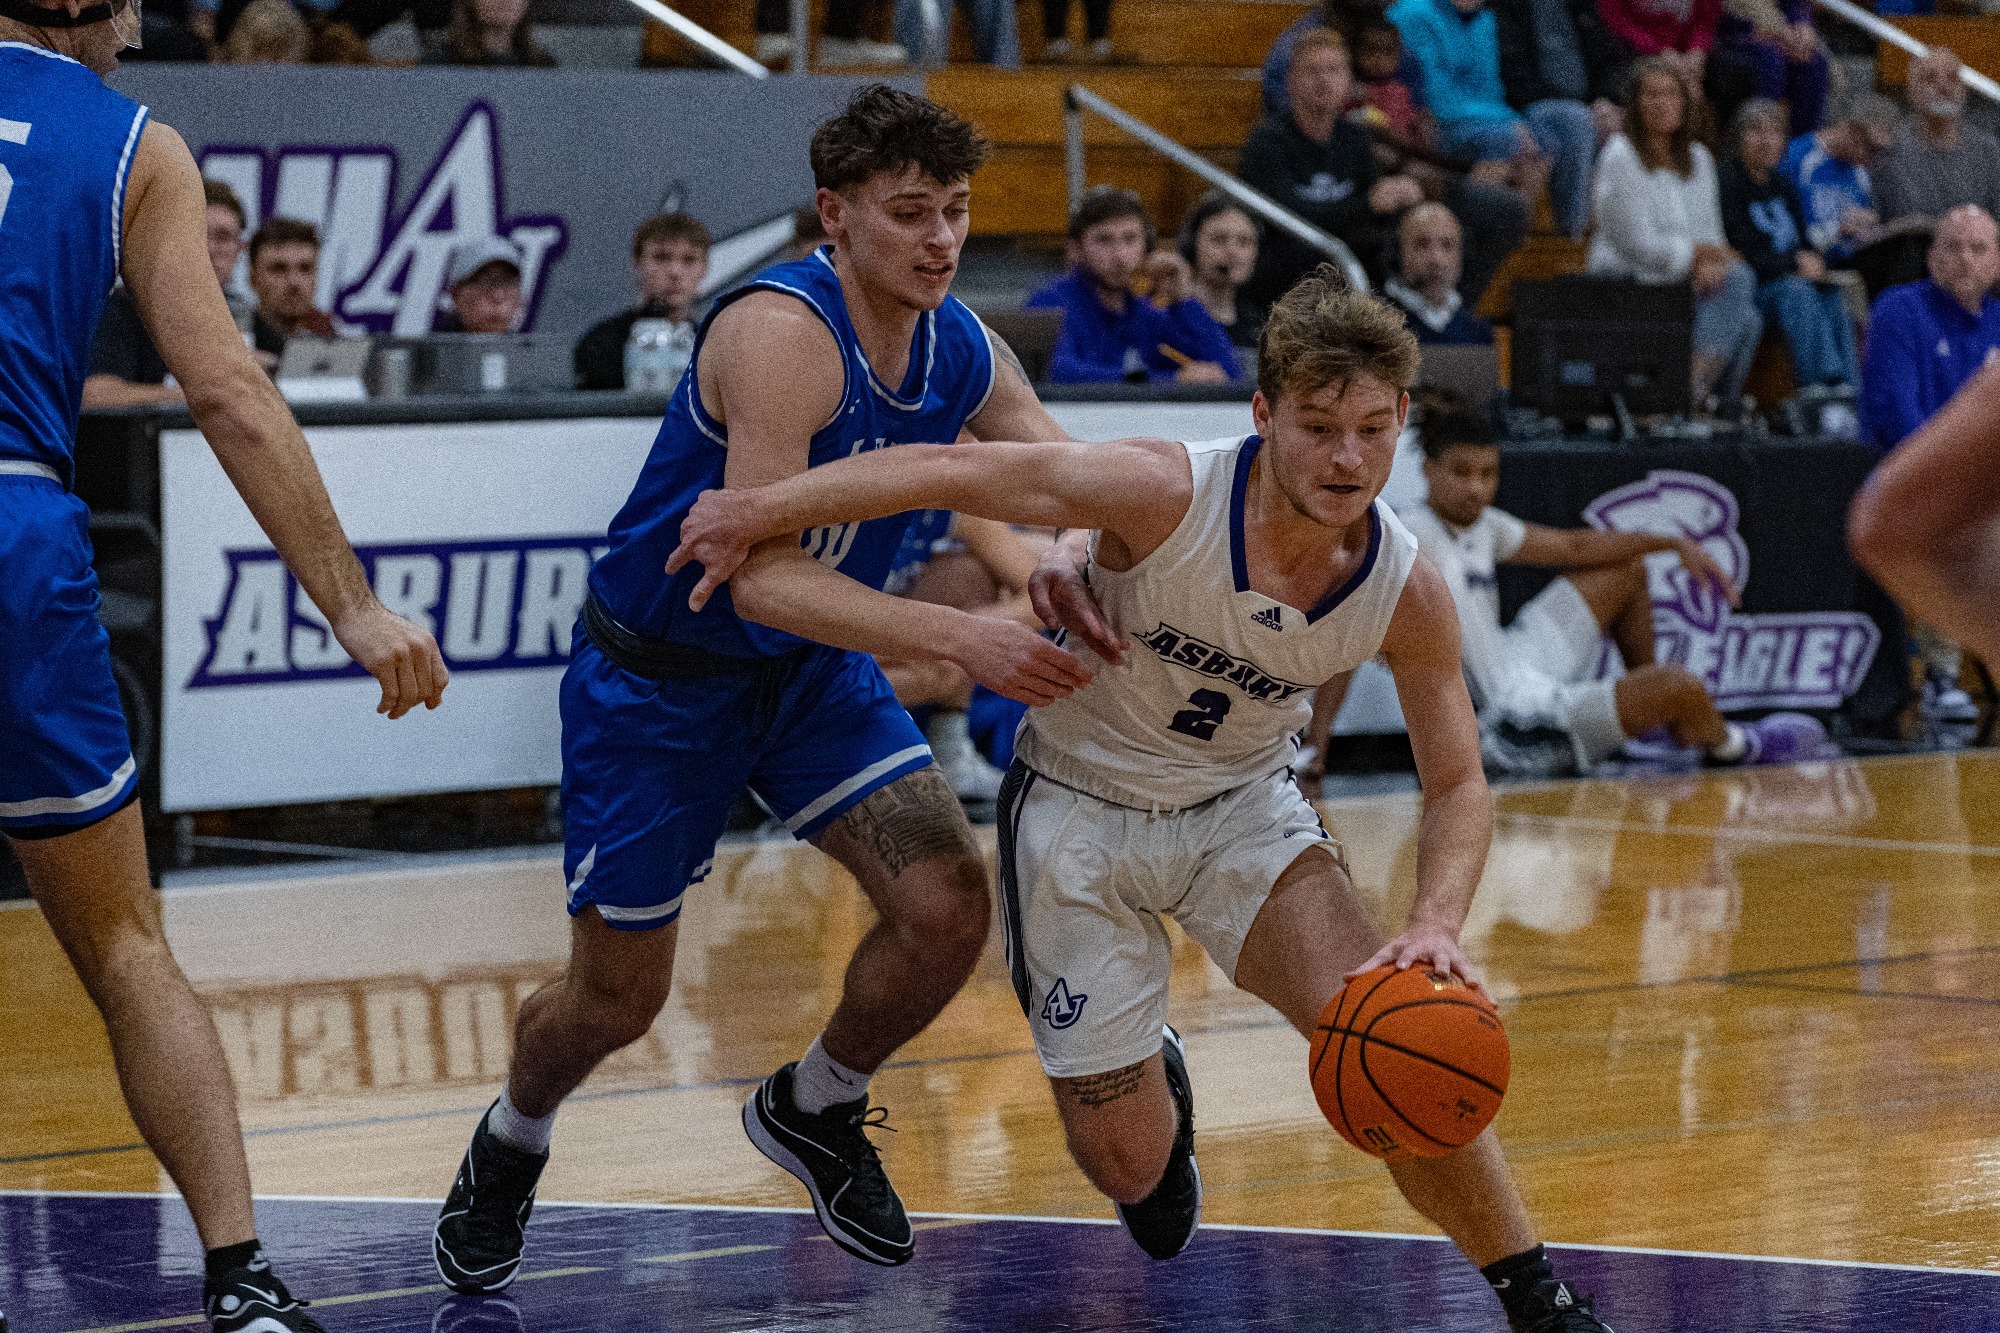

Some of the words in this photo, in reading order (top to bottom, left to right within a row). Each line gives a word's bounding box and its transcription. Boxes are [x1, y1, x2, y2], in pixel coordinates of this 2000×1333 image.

[203, 544, 610, 680] ABUR
[1251, 613, 1284, 632] adidas
[1147, 629, 1308, 702] ASBURY
[1167, 688, 1231, 741] 2
[1041, 977, 1088, 1030] AU
